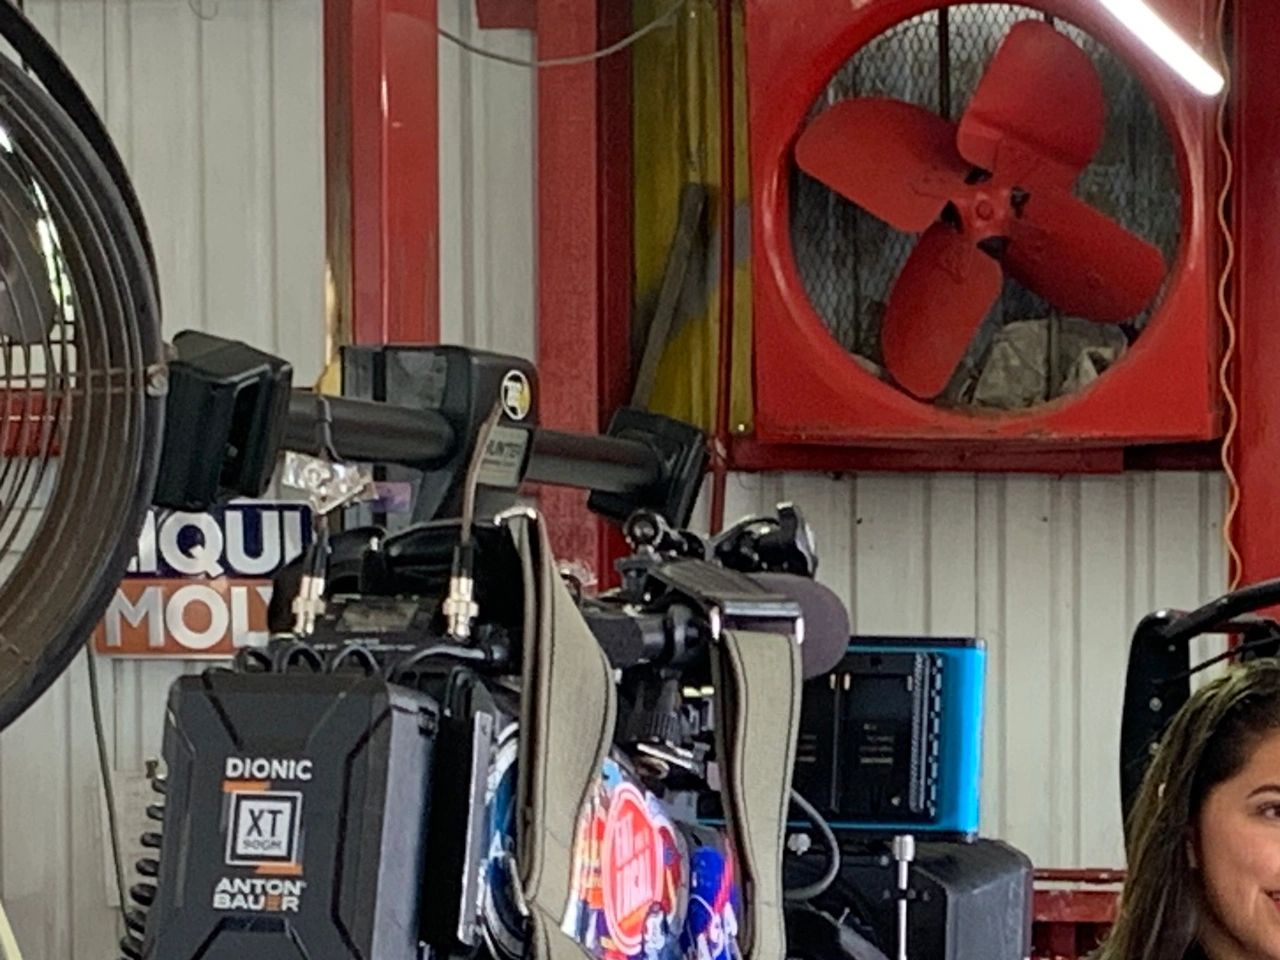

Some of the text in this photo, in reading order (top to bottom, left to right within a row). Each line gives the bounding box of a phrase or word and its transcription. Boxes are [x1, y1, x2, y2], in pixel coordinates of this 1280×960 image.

[127, 509, 303, 578] IQUI
[105, 584, 274, 651] MOL
[225, 757, 313, 781] DIONIC
[247, 808, 283, 838] XT
[214, 877, 303, 897] ANTON
[212, 892, 300, 913] BAUER
